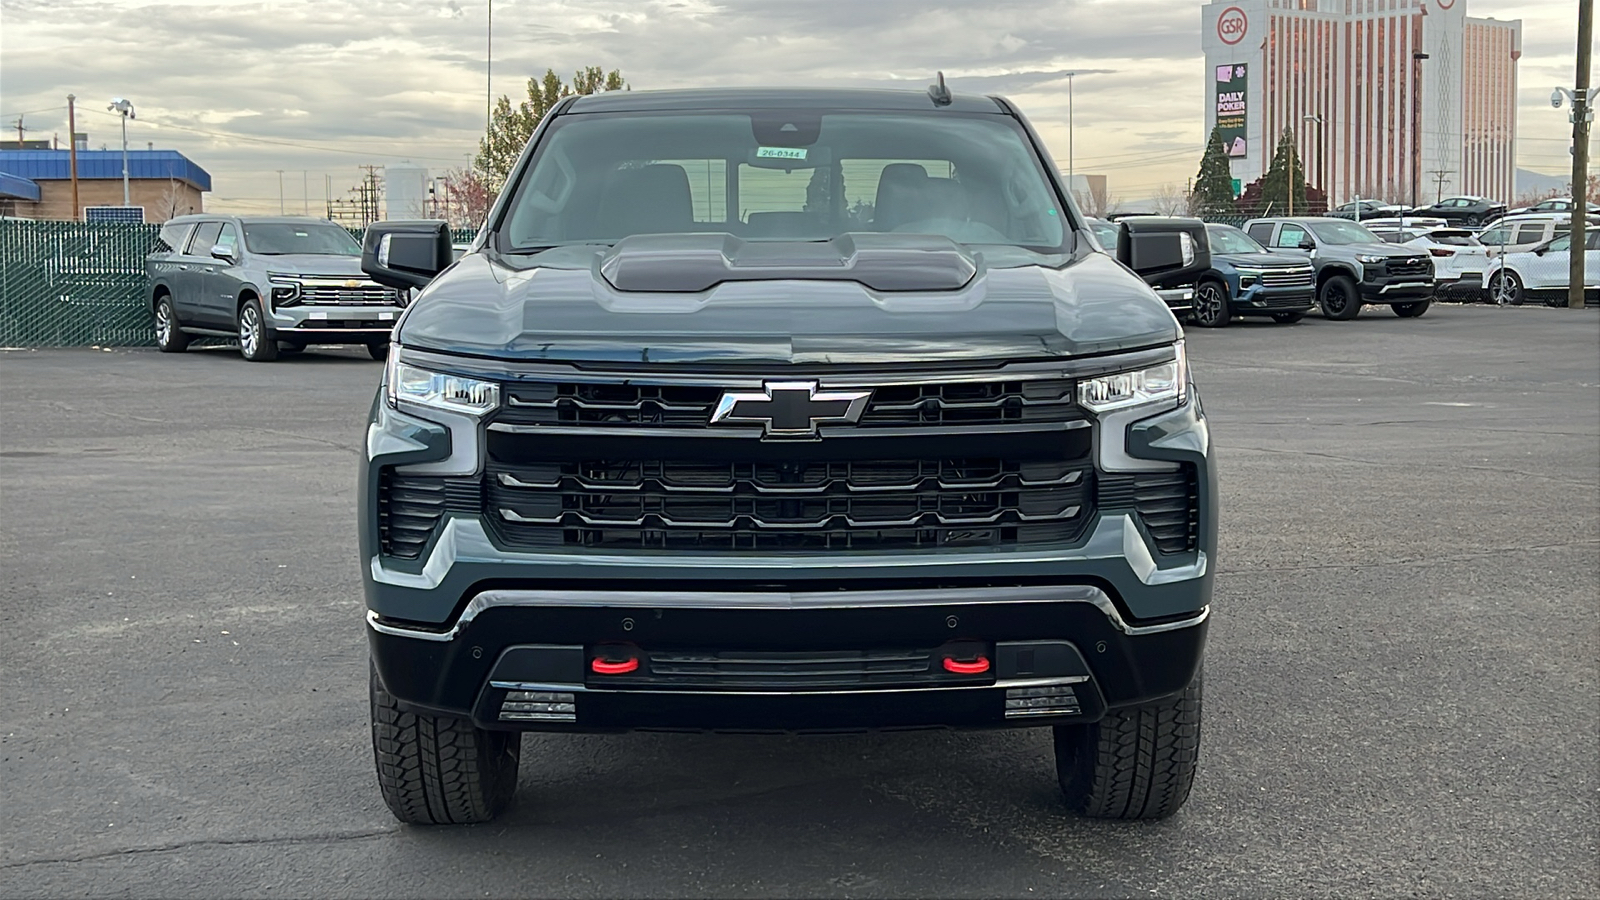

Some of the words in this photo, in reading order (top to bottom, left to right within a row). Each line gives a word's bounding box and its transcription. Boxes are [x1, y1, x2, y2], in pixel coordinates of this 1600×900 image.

[1221, 17, 1243, 34] GSR
[1218, 91, 1244, 103] DAILY
[1217, 101, 1245, 112] POKER
[762, 149, 800, 158] 26-0344
